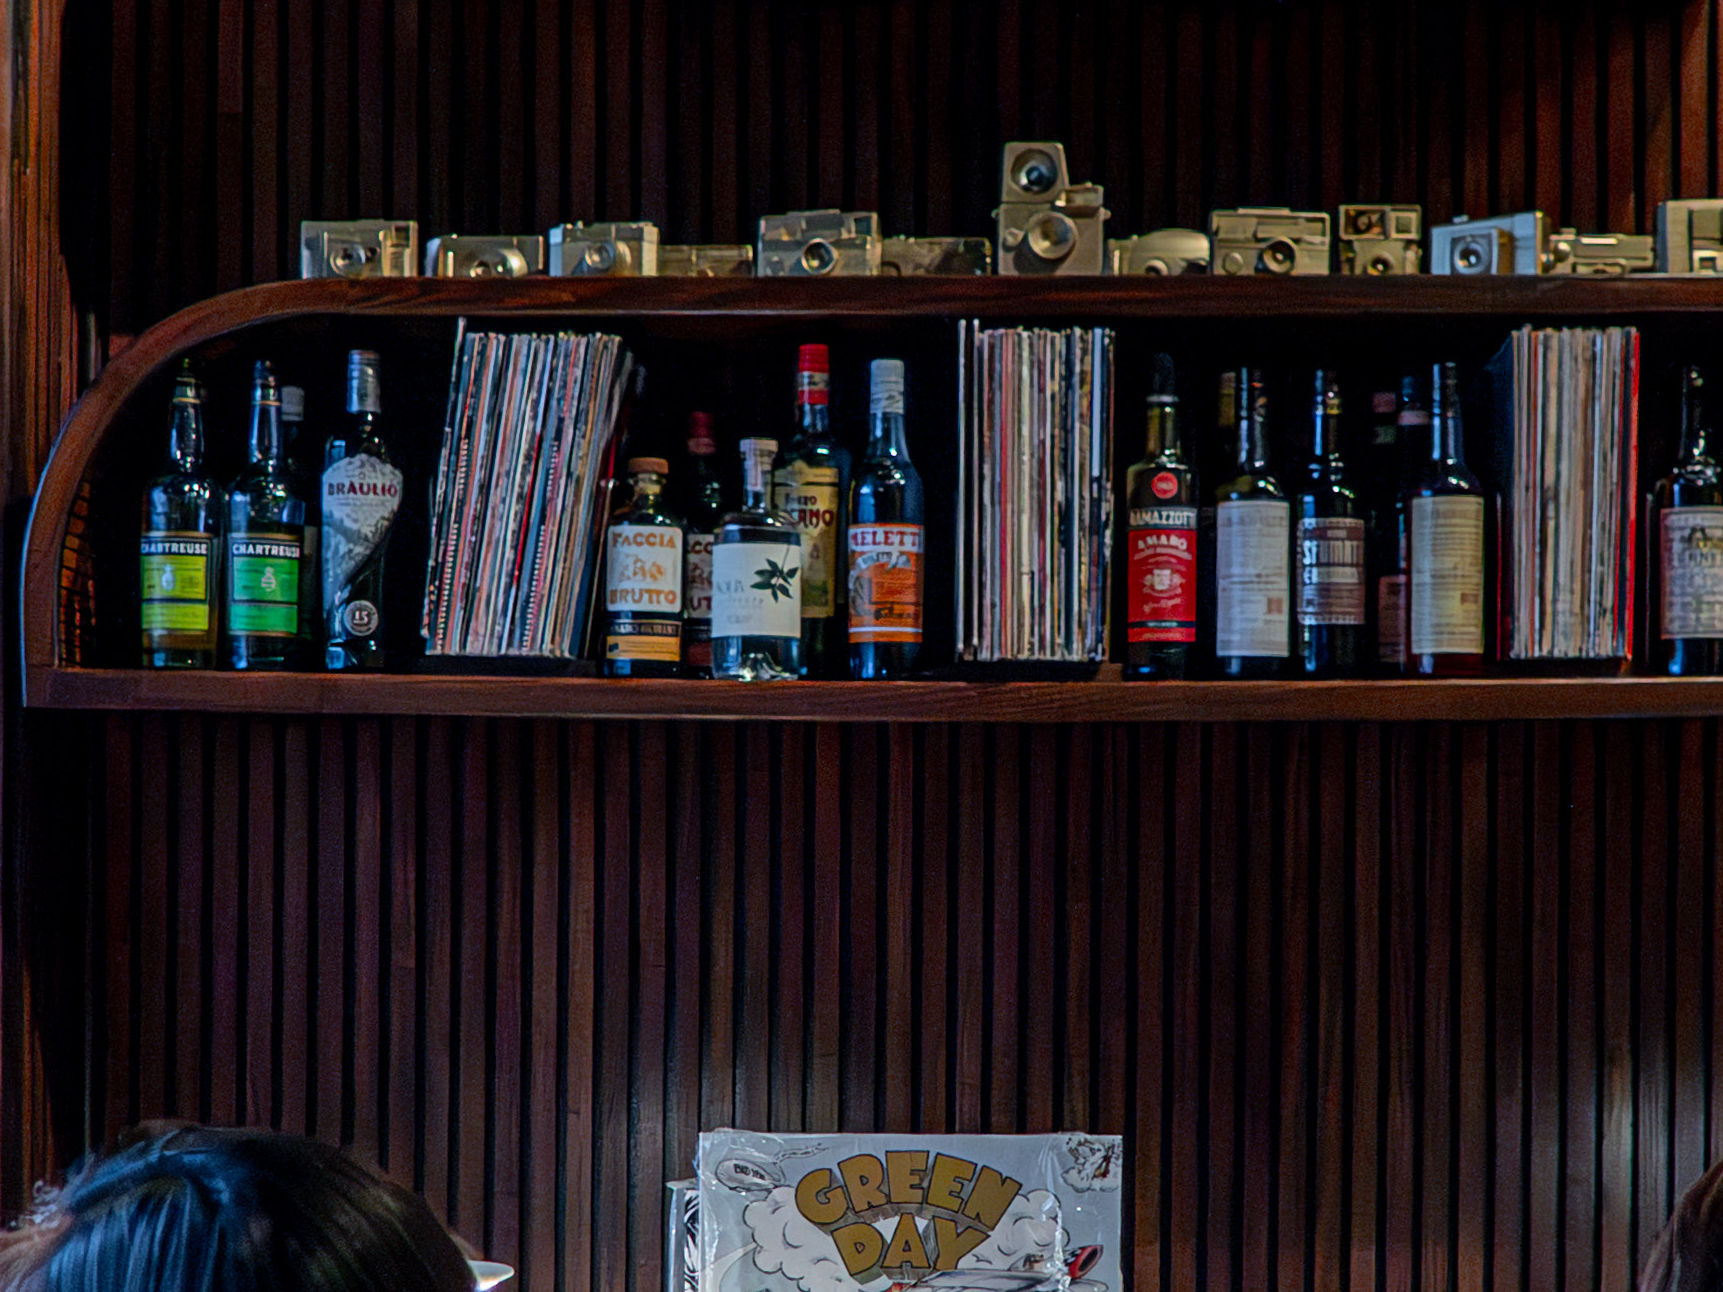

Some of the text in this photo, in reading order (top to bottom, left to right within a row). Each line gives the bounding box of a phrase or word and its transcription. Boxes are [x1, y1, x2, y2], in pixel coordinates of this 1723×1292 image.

[328, 480, 398, 498] BRAULIO
[612, 532, 677, 549] FACCIA
[851, 529, 919, 548] ELETT
[609, 587, 678, 605] BRUTTO
[795, 1150, 1023, 1233] GREEN
[831, 1212, 993, 1277] DAY
